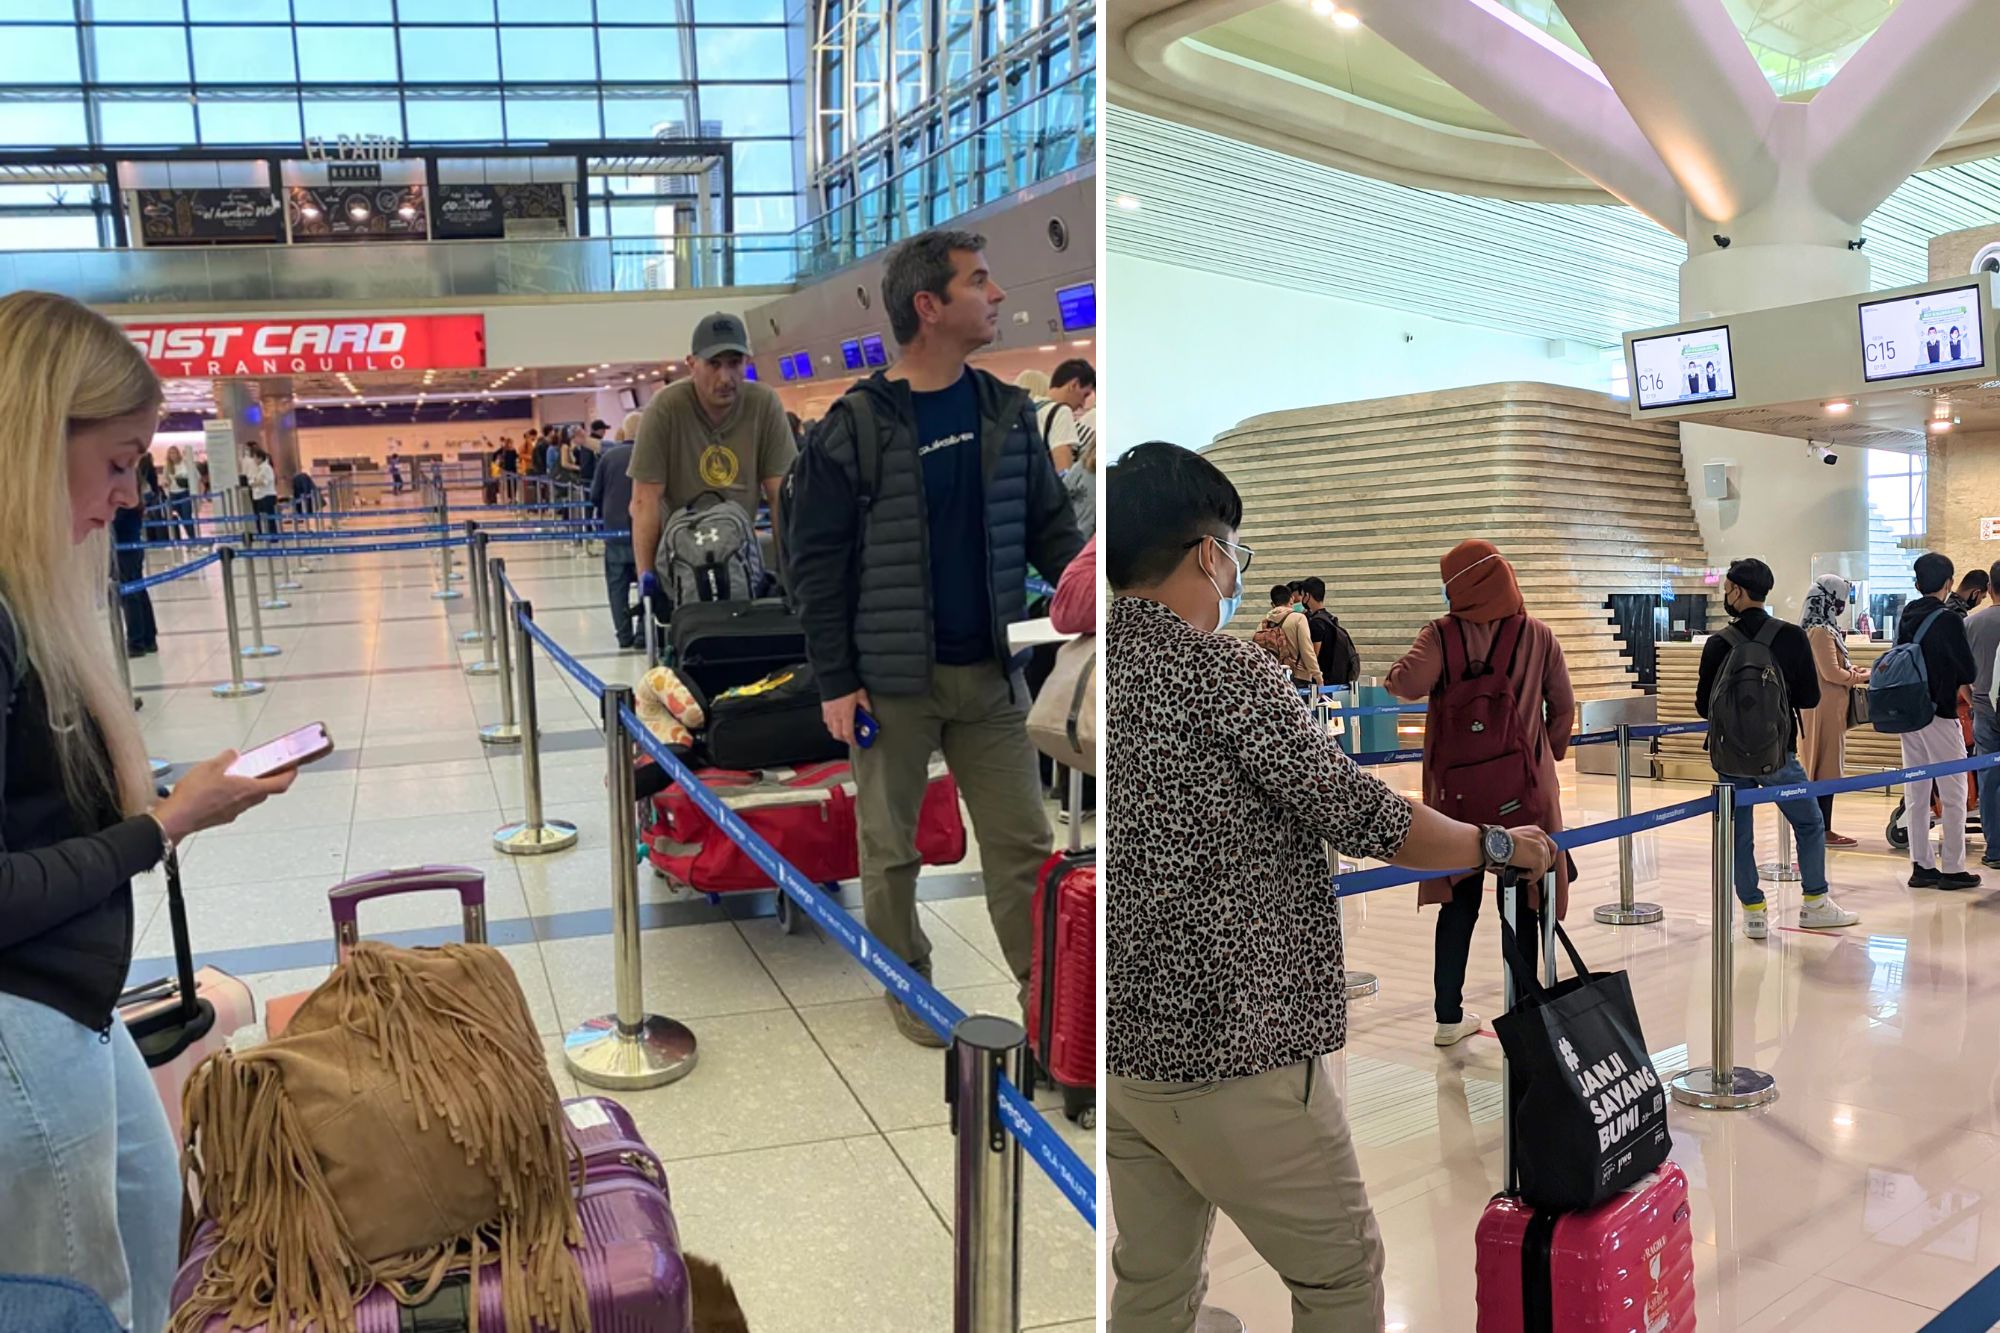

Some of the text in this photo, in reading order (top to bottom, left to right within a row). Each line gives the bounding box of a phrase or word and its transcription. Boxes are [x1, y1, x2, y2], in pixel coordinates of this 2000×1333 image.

[305, 133, 400, 163] EL PATIO
[252, 322, 407, 356] CARD
[1866, 341, 1896, 362] C15
[180, 355, 406, 376] TRANQUILO
[1639, 373, 1664, 391] C16
[1577, 1052, 1628, 1098] JANJI
[1590, 1066, 1657, 1124] SAYANG
[1598, 1104, 1640, 1153] BUMI
